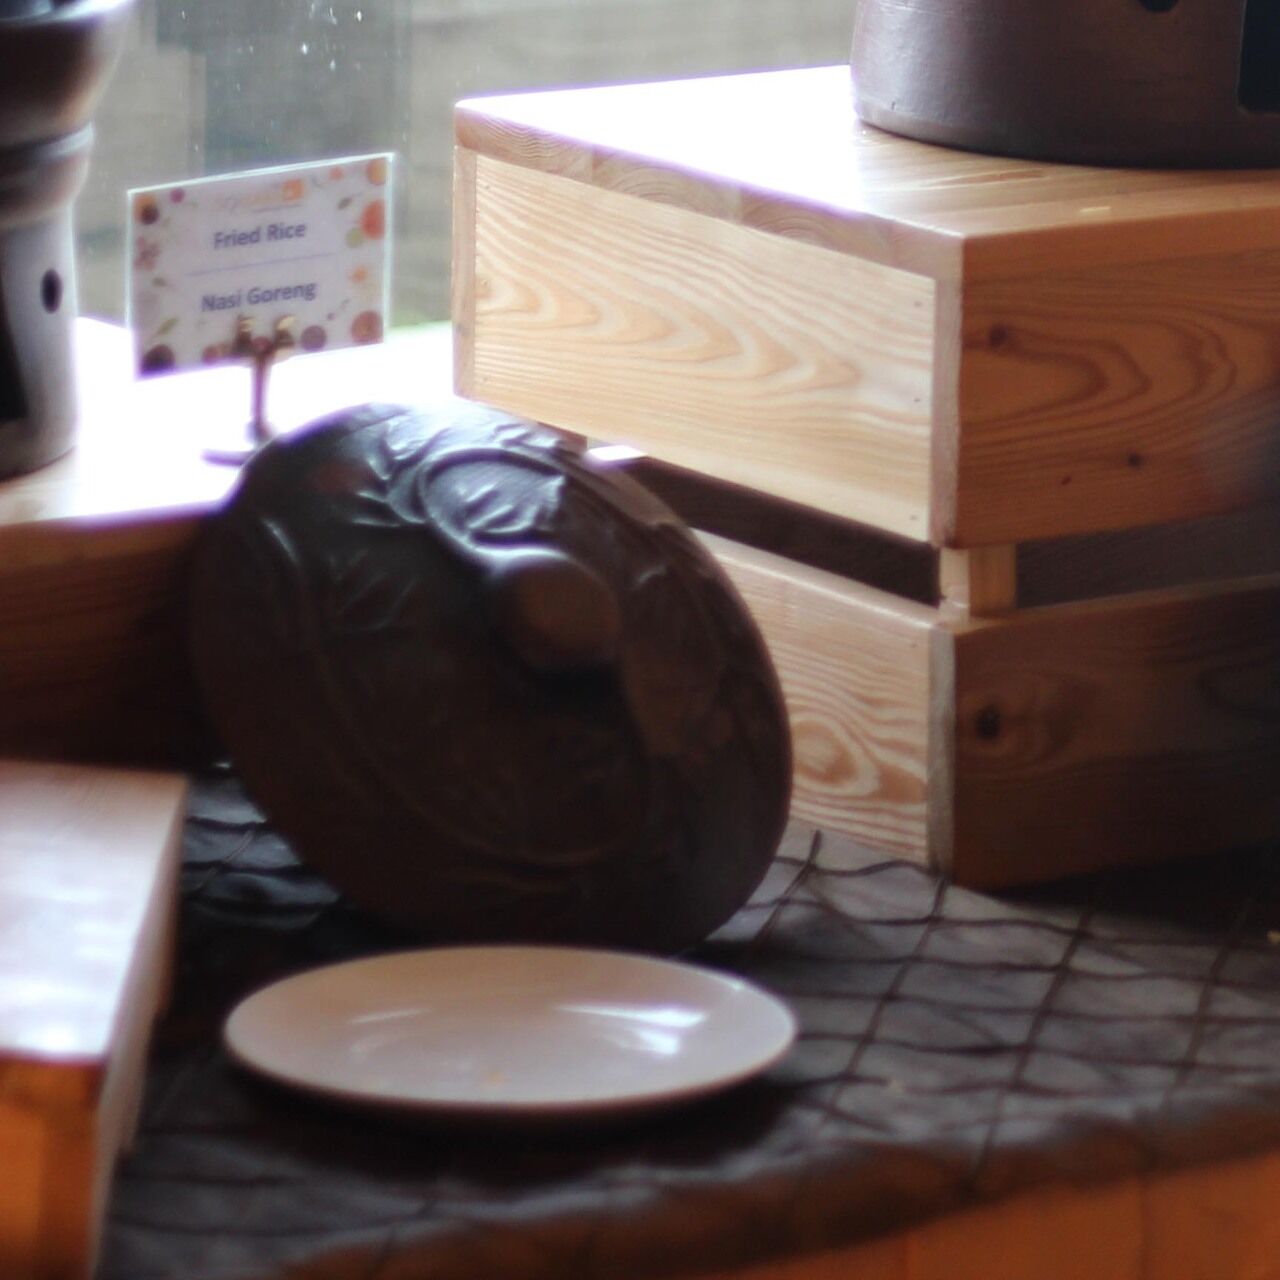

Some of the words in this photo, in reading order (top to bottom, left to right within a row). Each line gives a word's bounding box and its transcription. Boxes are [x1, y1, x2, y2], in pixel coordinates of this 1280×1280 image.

[214, 227, 261, 249] Fried
[266, 223, 306, 241] Rice
[202, 289, 242, 312] Nasi
[247, 283, 317, 305] Goreng
